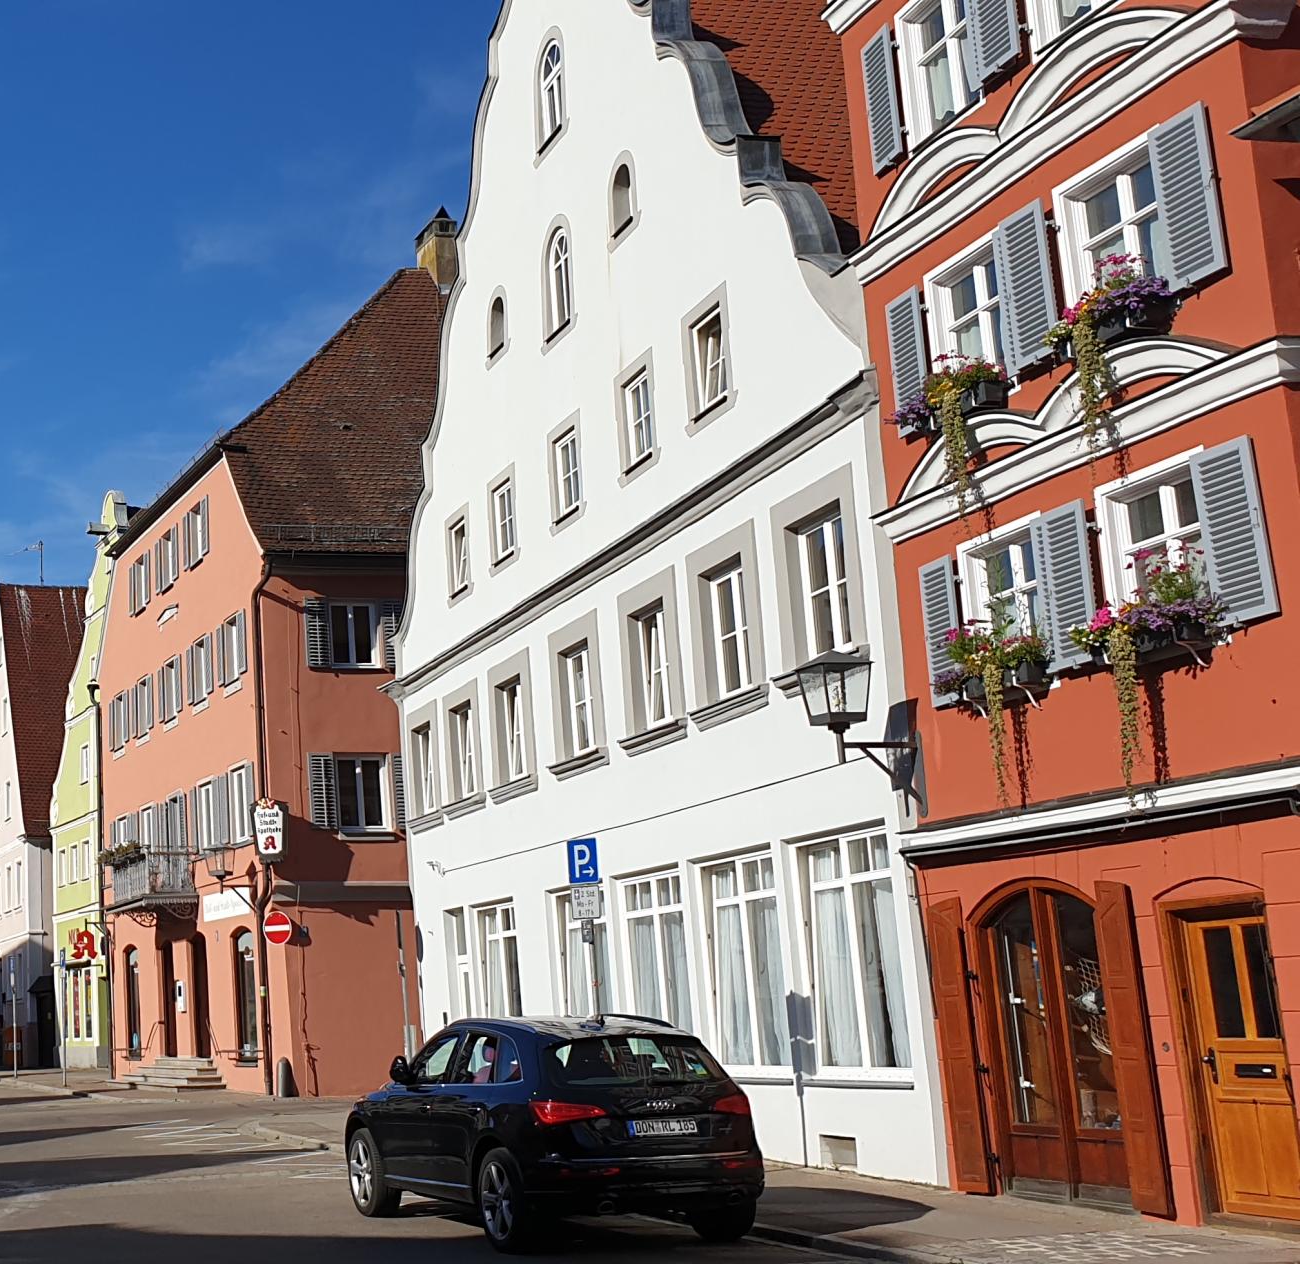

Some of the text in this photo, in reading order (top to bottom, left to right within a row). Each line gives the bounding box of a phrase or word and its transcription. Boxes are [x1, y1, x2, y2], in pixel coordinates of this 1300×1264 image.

[573, 844, 590, 878] P
[635, 1120, 655, 1134] DON
[660, 1120, 675, 1132] RL
